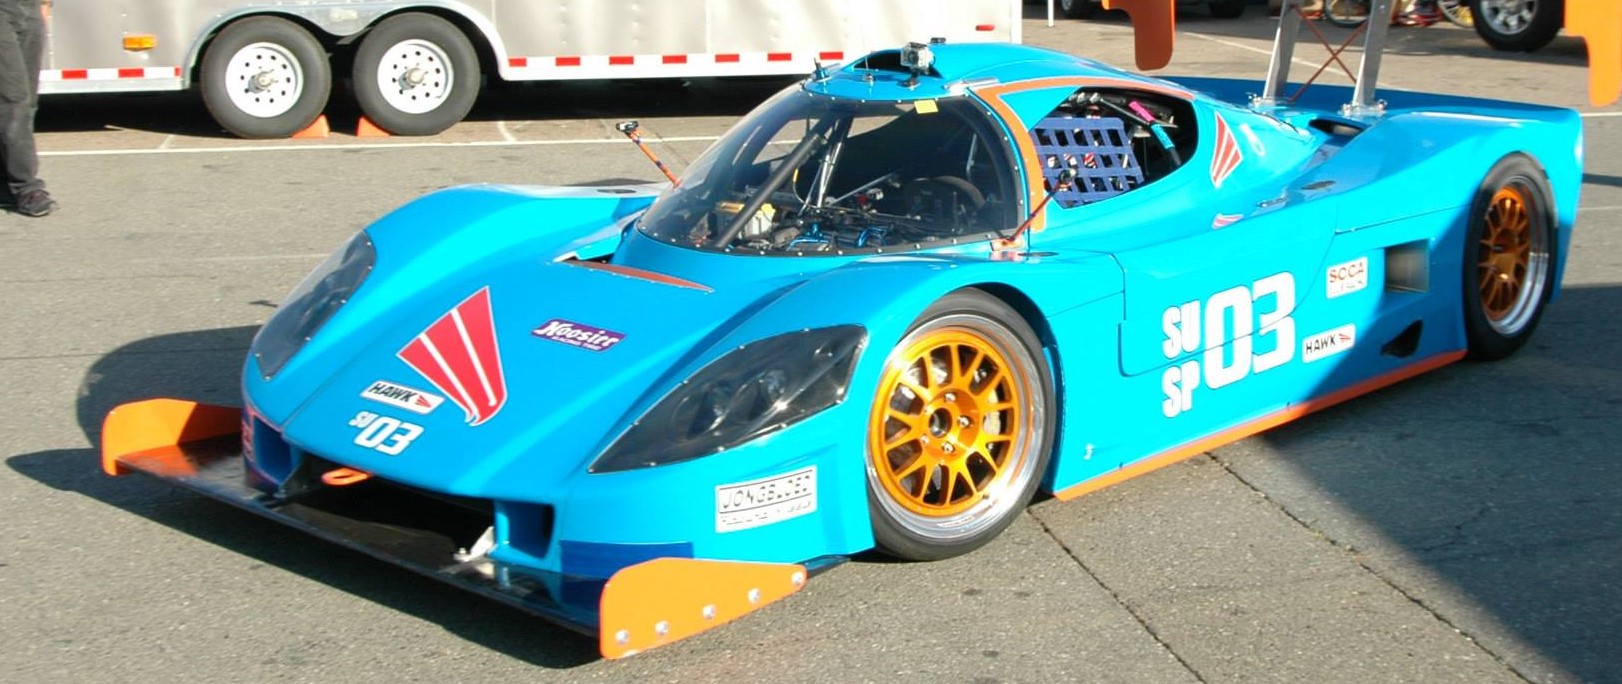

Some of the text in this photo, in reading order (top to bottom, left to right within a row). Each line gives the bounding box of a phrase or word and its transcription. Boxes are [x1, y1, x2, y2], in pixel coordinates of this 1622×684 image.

[1329, 261, 1364, 283] SCCA
[533, 321, 620, 347] Hoosier
[1162, 271, 1296, 390] SU 03
[1305, 334, 1336, 354] HAWK
[368, 382, 418, 402] HAWK
[1162, 360, 1201, 418] SP
[353, 416, 425, 456] 03
